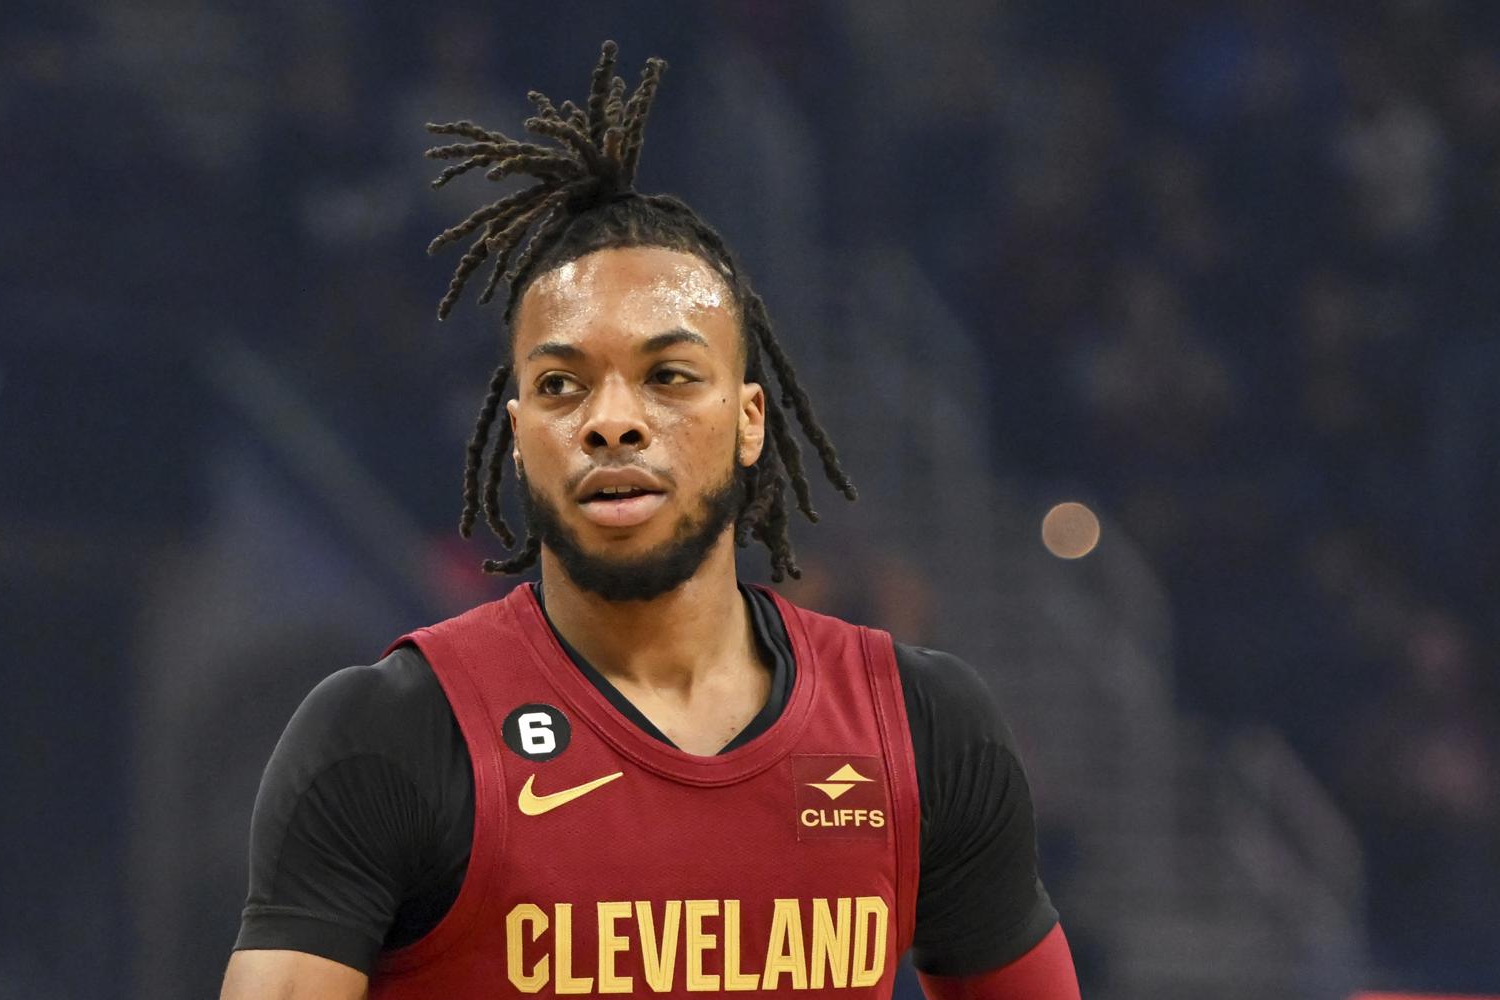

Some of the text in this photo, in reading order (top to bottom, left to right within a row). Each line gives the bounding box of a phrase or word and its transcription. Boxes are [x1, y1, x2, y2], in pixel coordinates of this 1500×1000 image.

[518, 712, 556, 755] 6
[801, 808, 885, 828] CLIFFS
[505, 896, 890, 995] CLEVELAND
